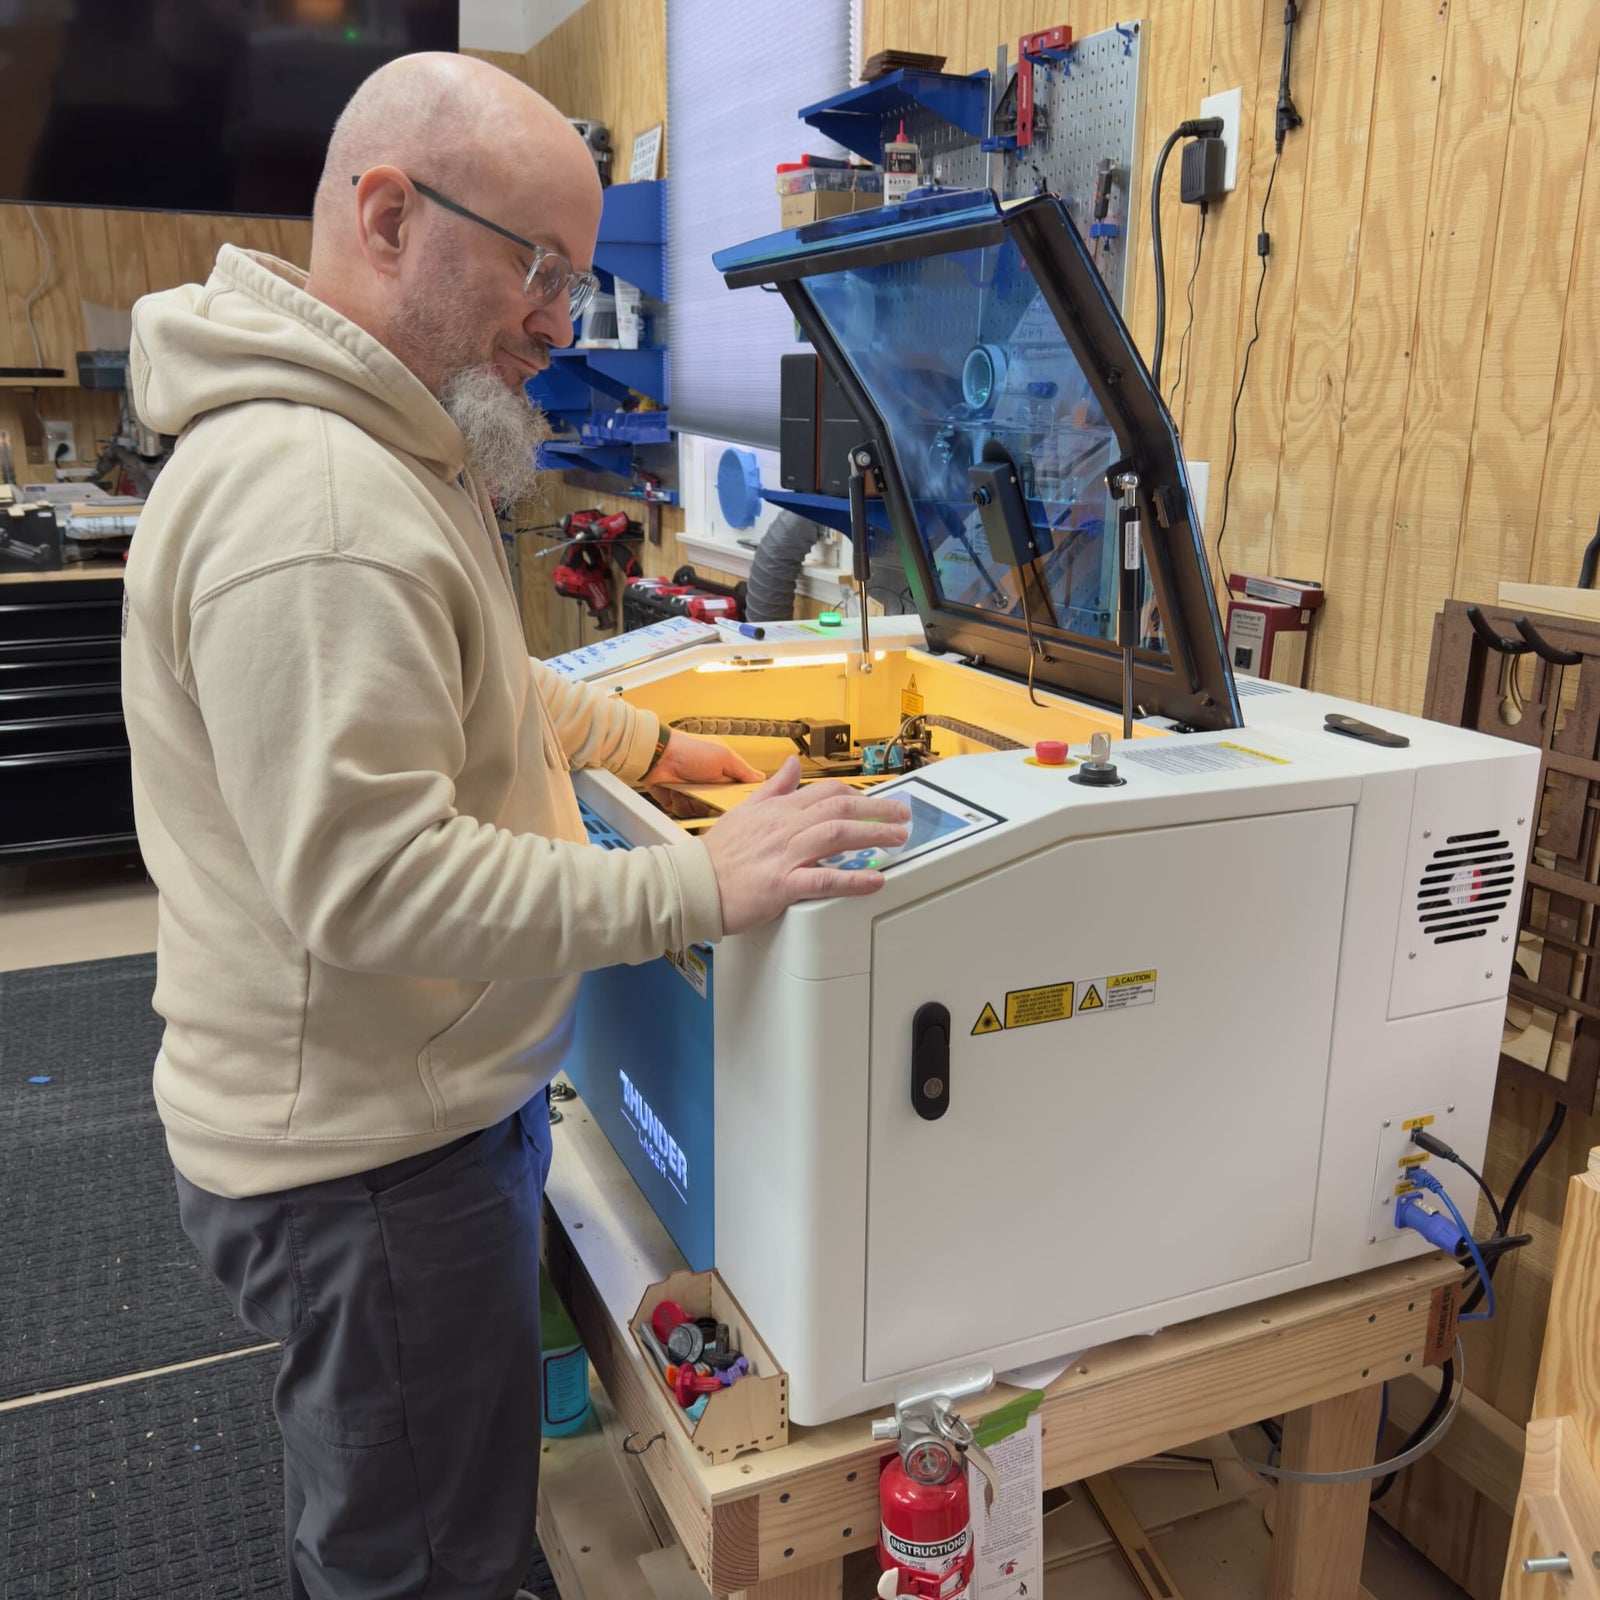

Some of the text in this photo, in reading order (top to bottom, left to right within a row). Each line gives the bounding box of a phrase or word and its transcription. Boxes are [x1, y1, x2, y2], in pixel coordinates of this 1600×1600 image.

[1121, 973, 1151, 984] CAUTION
[619, 1069, 688, 1189] THUNDER
[891, 1533, 966, 1556] INSTRUCTIONS
